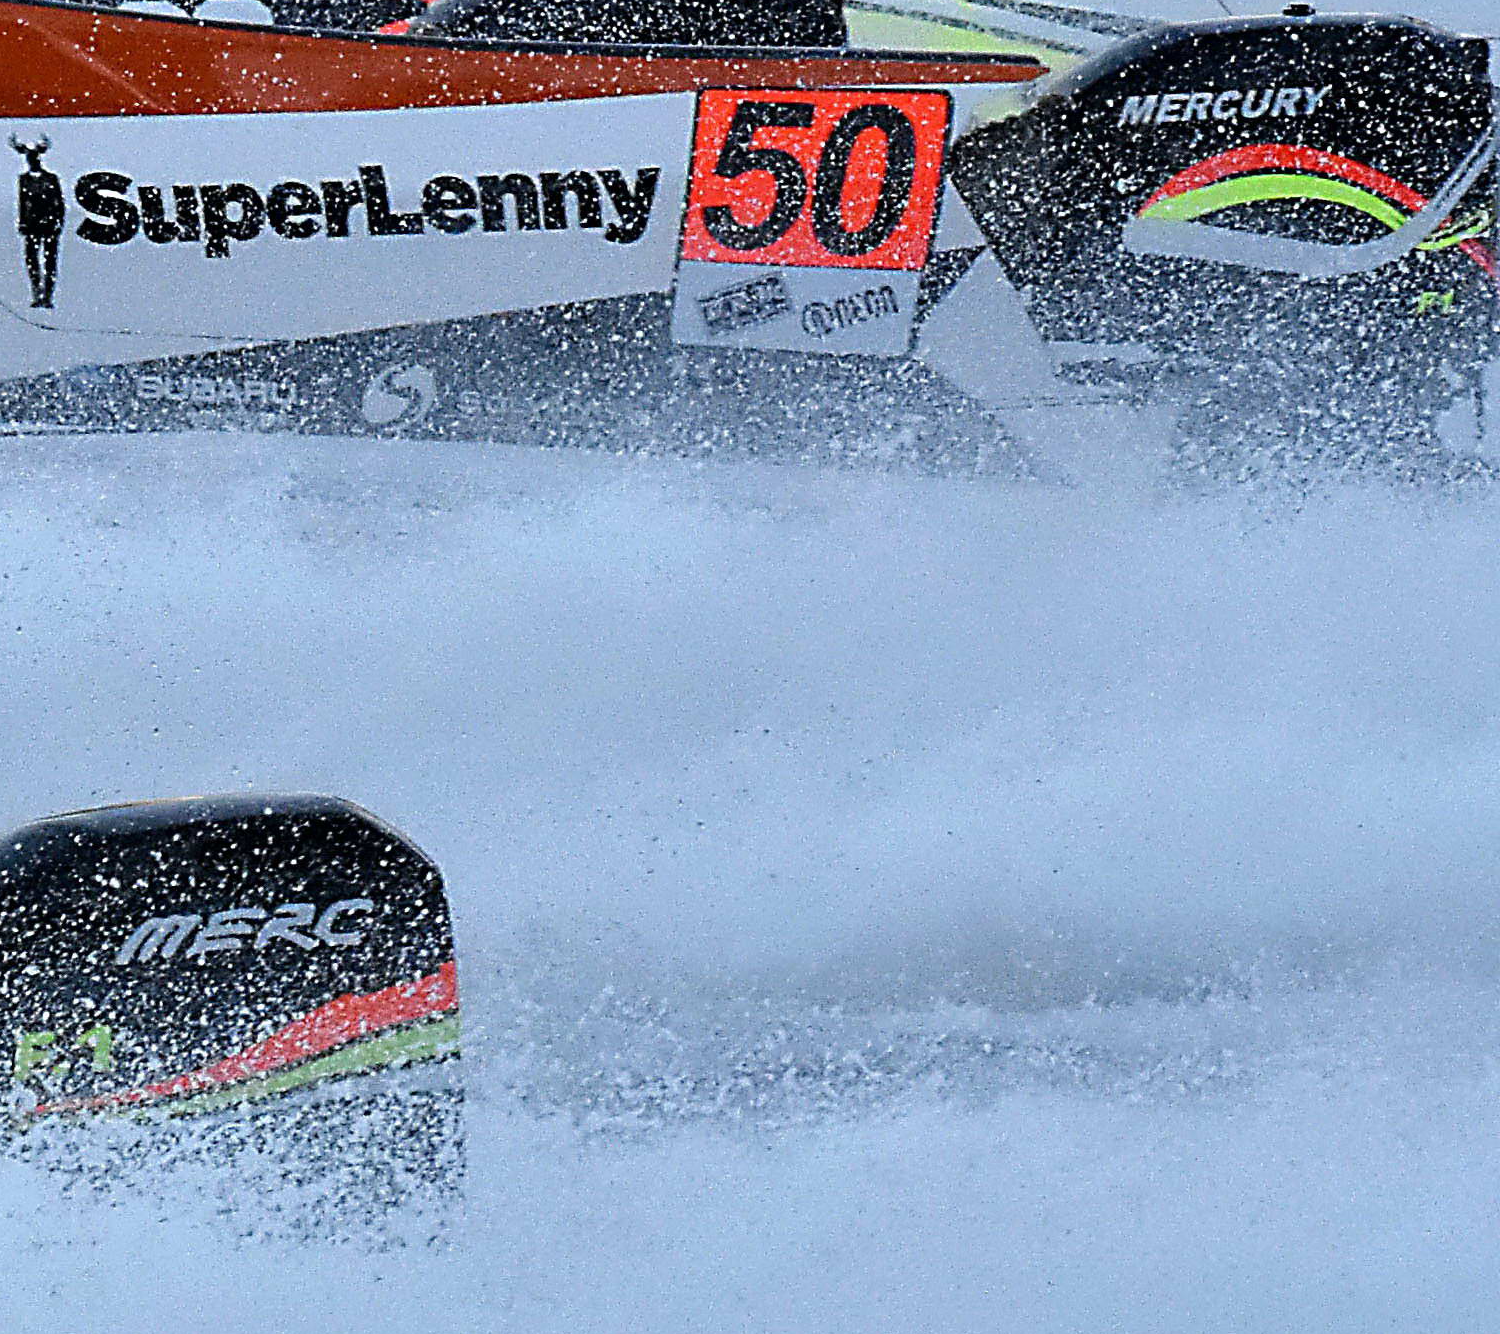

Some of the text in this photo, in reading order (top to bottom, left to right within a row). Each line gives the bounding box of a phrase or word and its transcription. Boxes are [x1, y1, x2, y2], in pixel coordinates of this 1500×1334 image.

[1118, 86, 1330, 127] MERCURY
[74, 164, 661, 259] SuperLenny
[702, 102, 916, 258] 50
[113, 897, 376, 967] MERC
